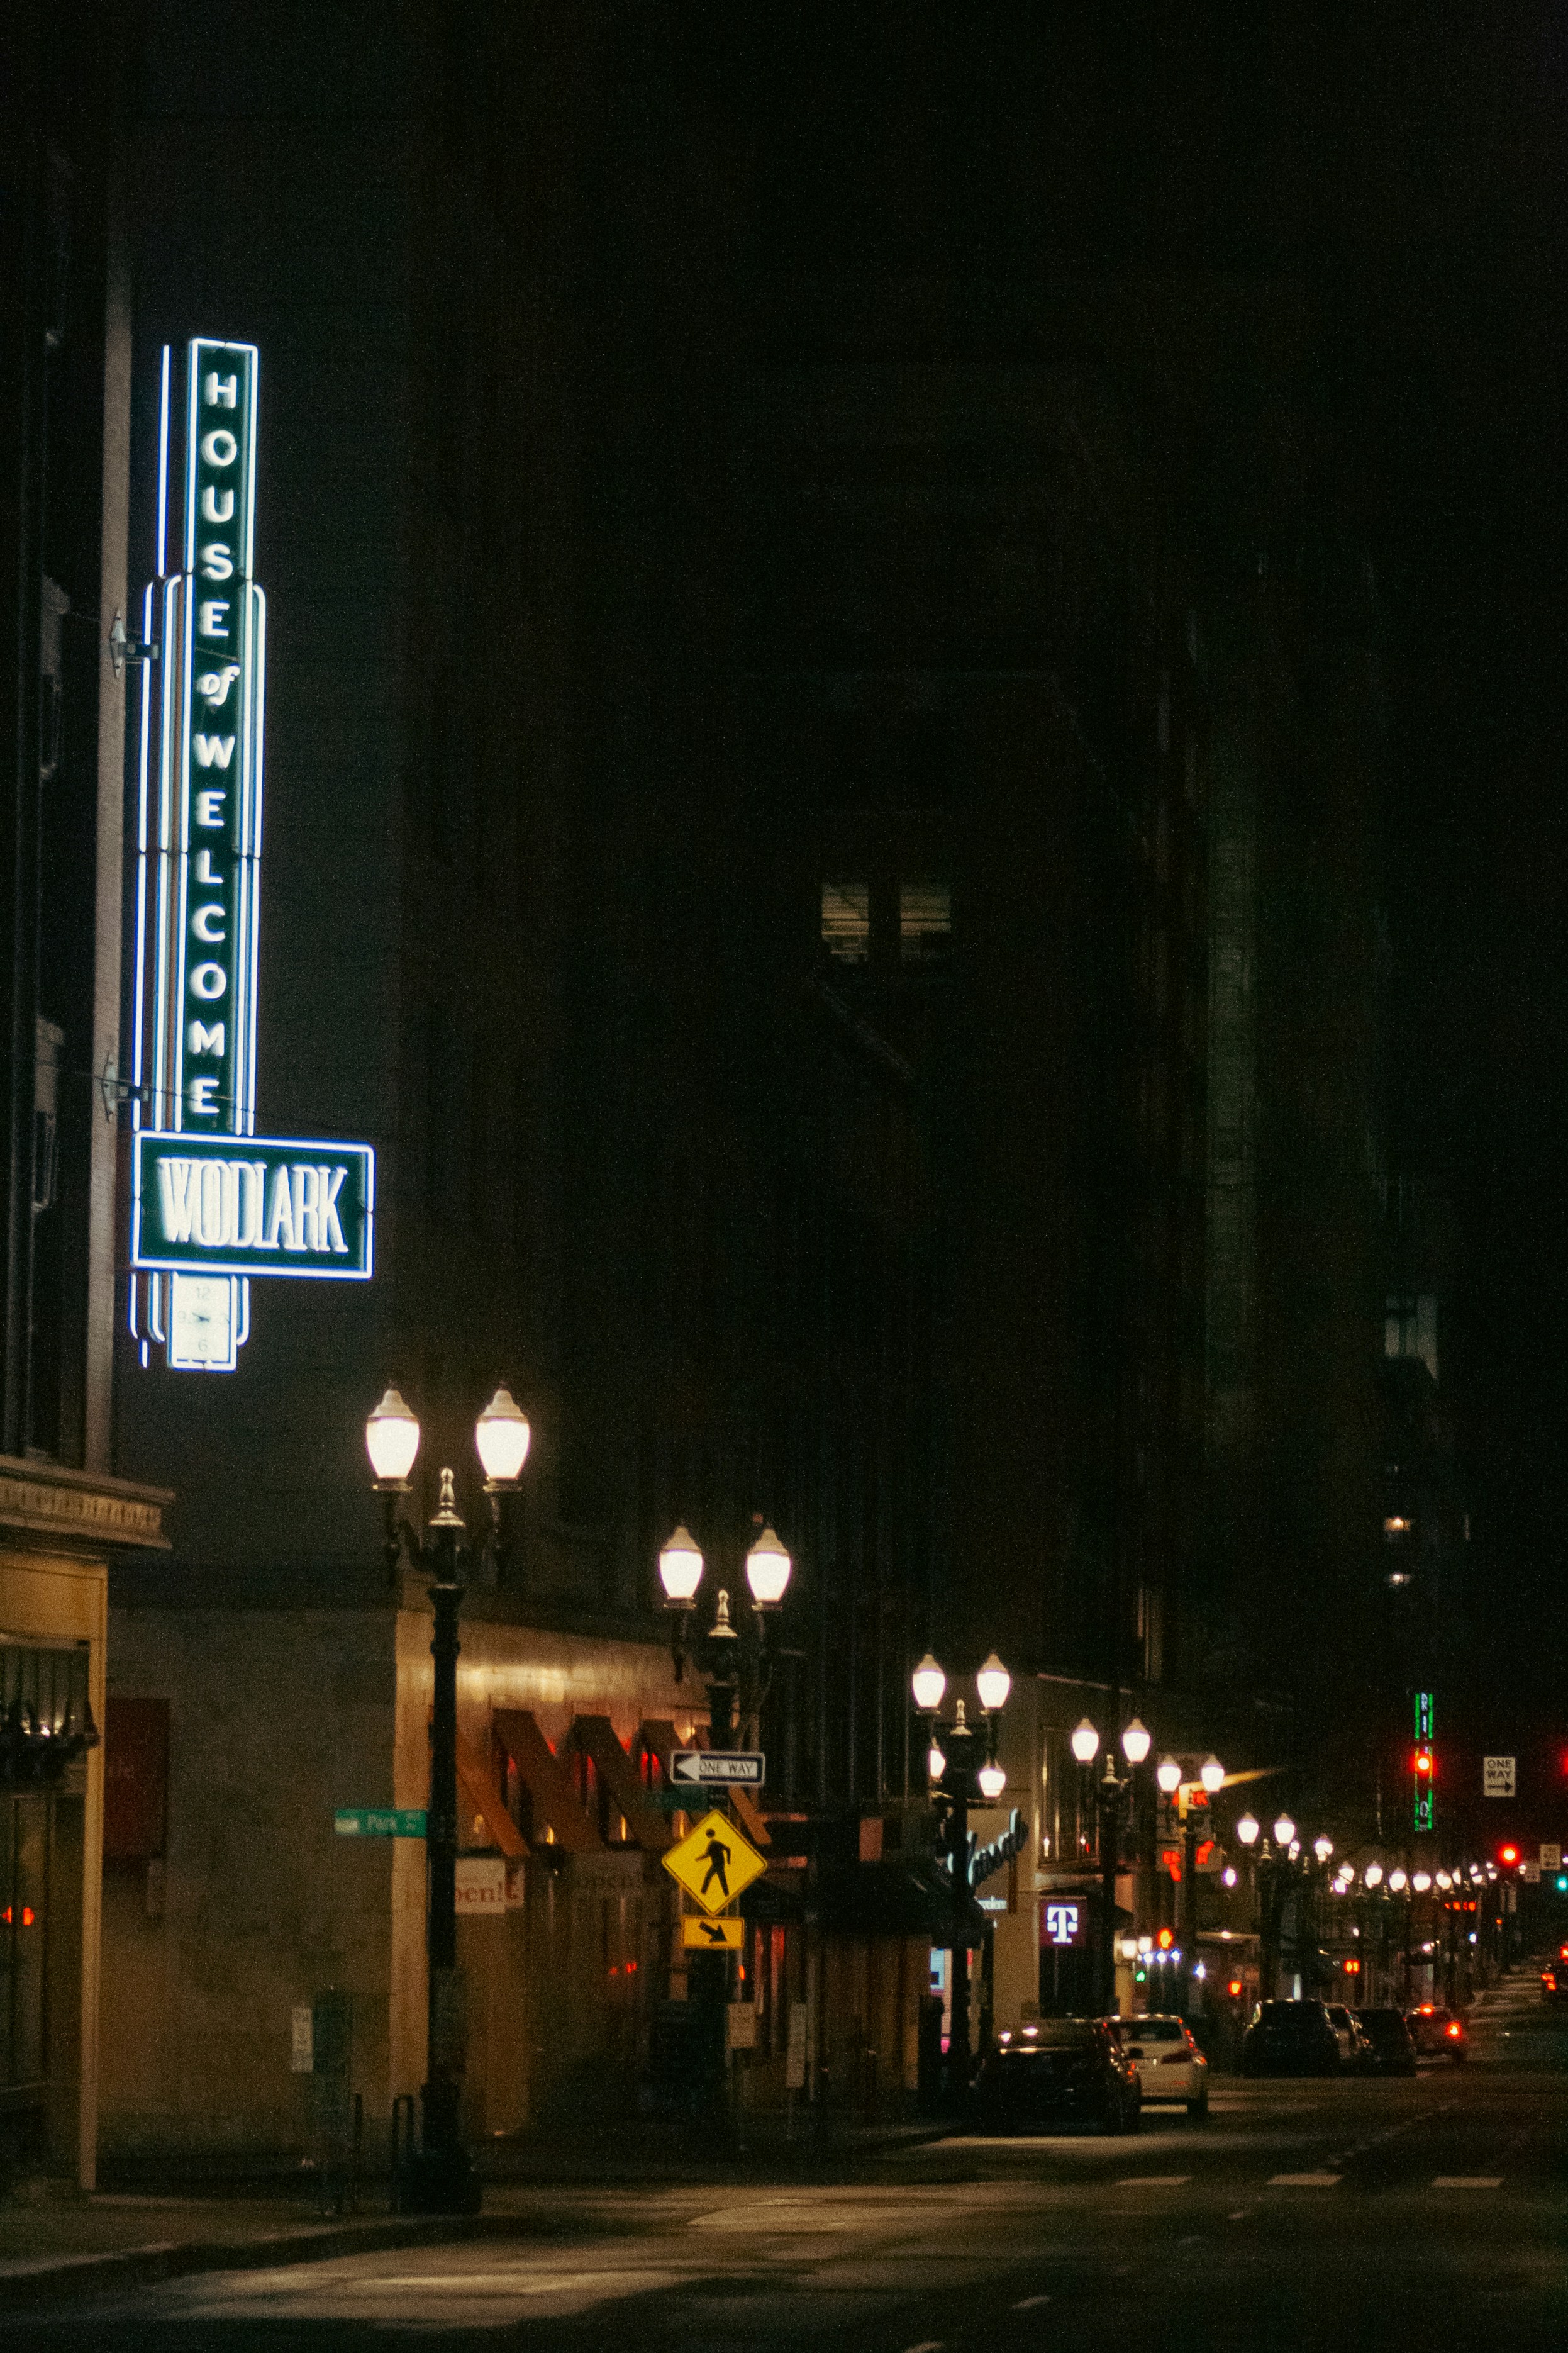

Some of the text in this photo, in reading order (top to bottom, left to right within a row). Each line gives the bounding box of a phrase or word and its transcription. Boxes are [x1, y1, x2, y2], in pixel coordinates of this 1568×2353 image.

[189, 371, 240, 1114] HOUSE of WELCOME
[700, 1762, 751, 1774] ONE WAY
[1487, 1759, 1511, 1769] ONE
[1486, 1770, 1511, 1779] WAY
[1047, 1906, 1078, 1943] T
